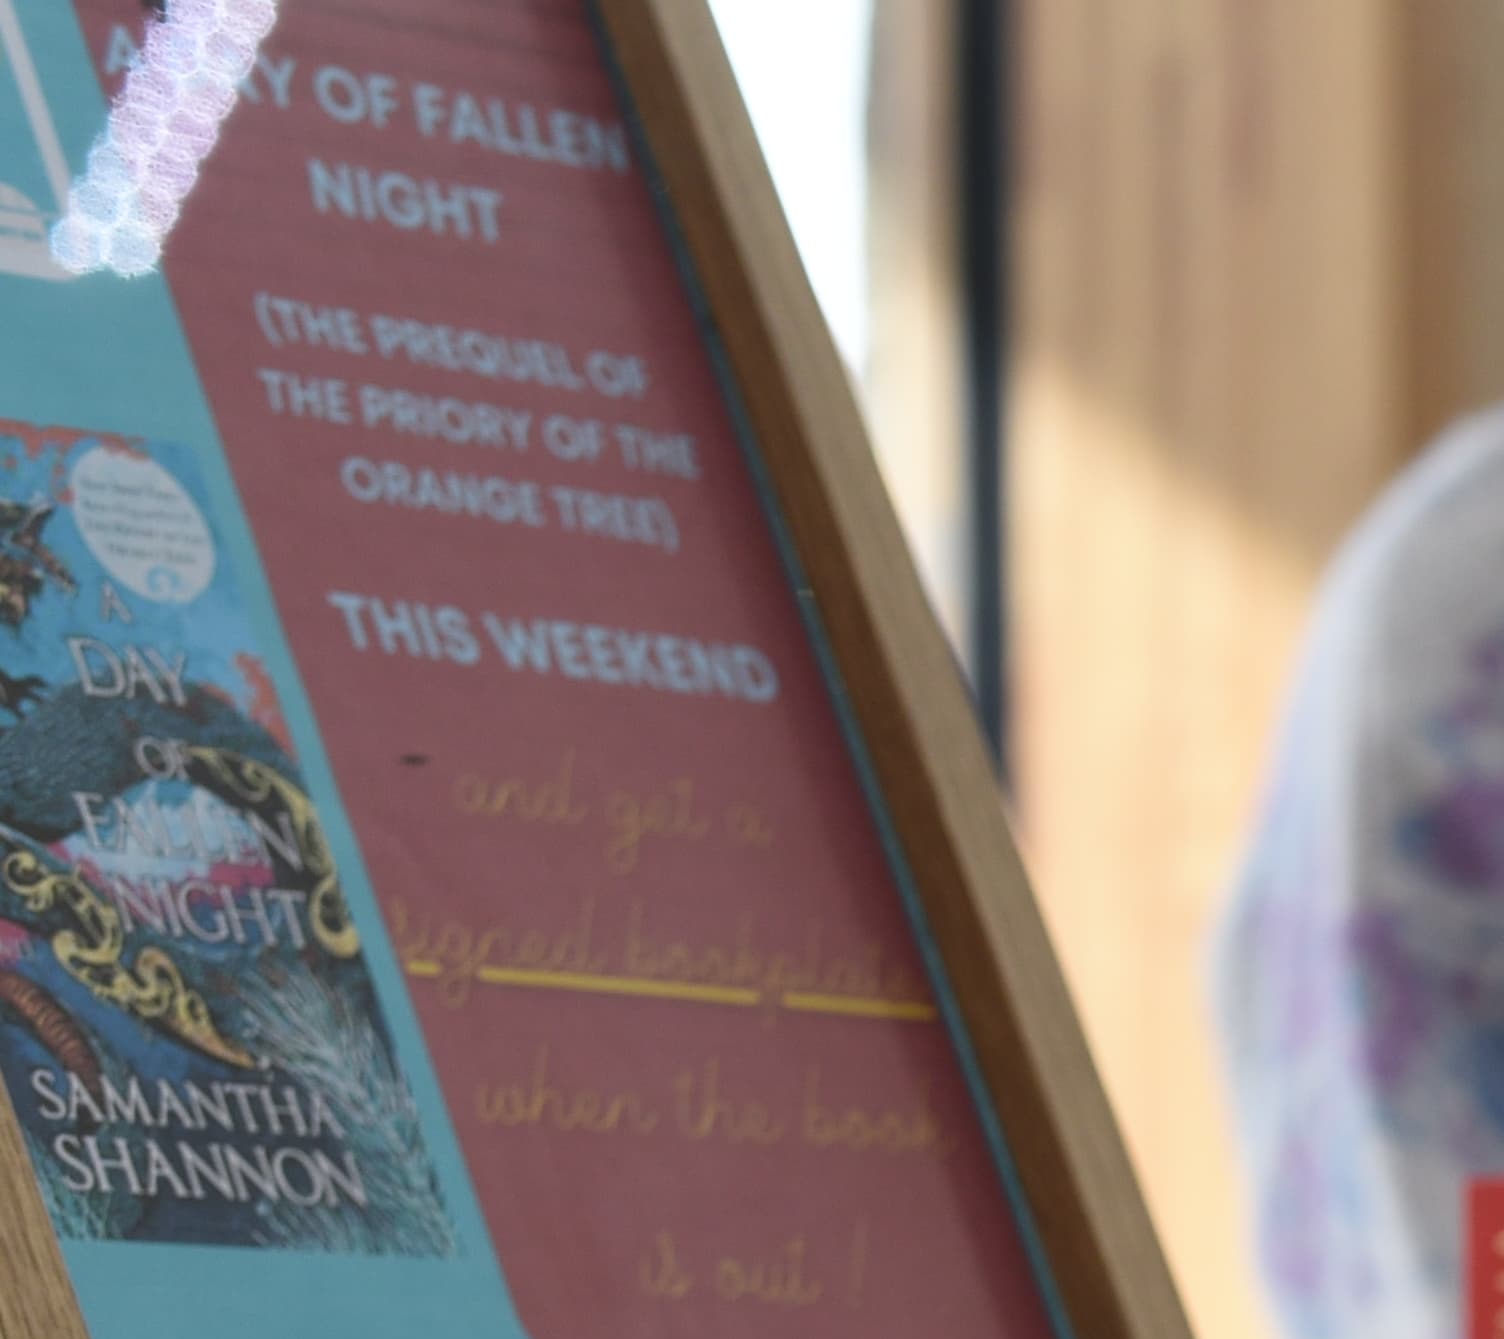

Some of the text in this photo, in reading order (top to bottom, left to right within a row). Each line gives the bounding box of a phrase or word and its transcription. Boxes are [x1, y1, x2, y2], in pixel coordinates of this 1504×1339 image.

[313, 66, 398, 129] OF
[411, 85, 631, 172] FALLEN
[307, 158, 503, 243] NIGHT
[253, 291, 648, 398] (THE PREQUEL OF
[258, 368, 699, 480] THE PRIORY OF THE
[340, 456, 681, 554] ORANGE TREE)
[66, 634, 187, 707] DAY
[326, 592, 779, 703] THIS WEEKEND
[133, 736, 192, 780] OF
[454, 747, 590, 824] and
[72, 790, 303, 873] FALLEN
[113, 873, 308, 949] NIGHT
[30, 1069, 346, 1140] SAMANTHA
[474, 1042, 660, 1137] when
[674, 1056, 786, 1146] the
[53, 1134, 368, 1209] SHANNON
